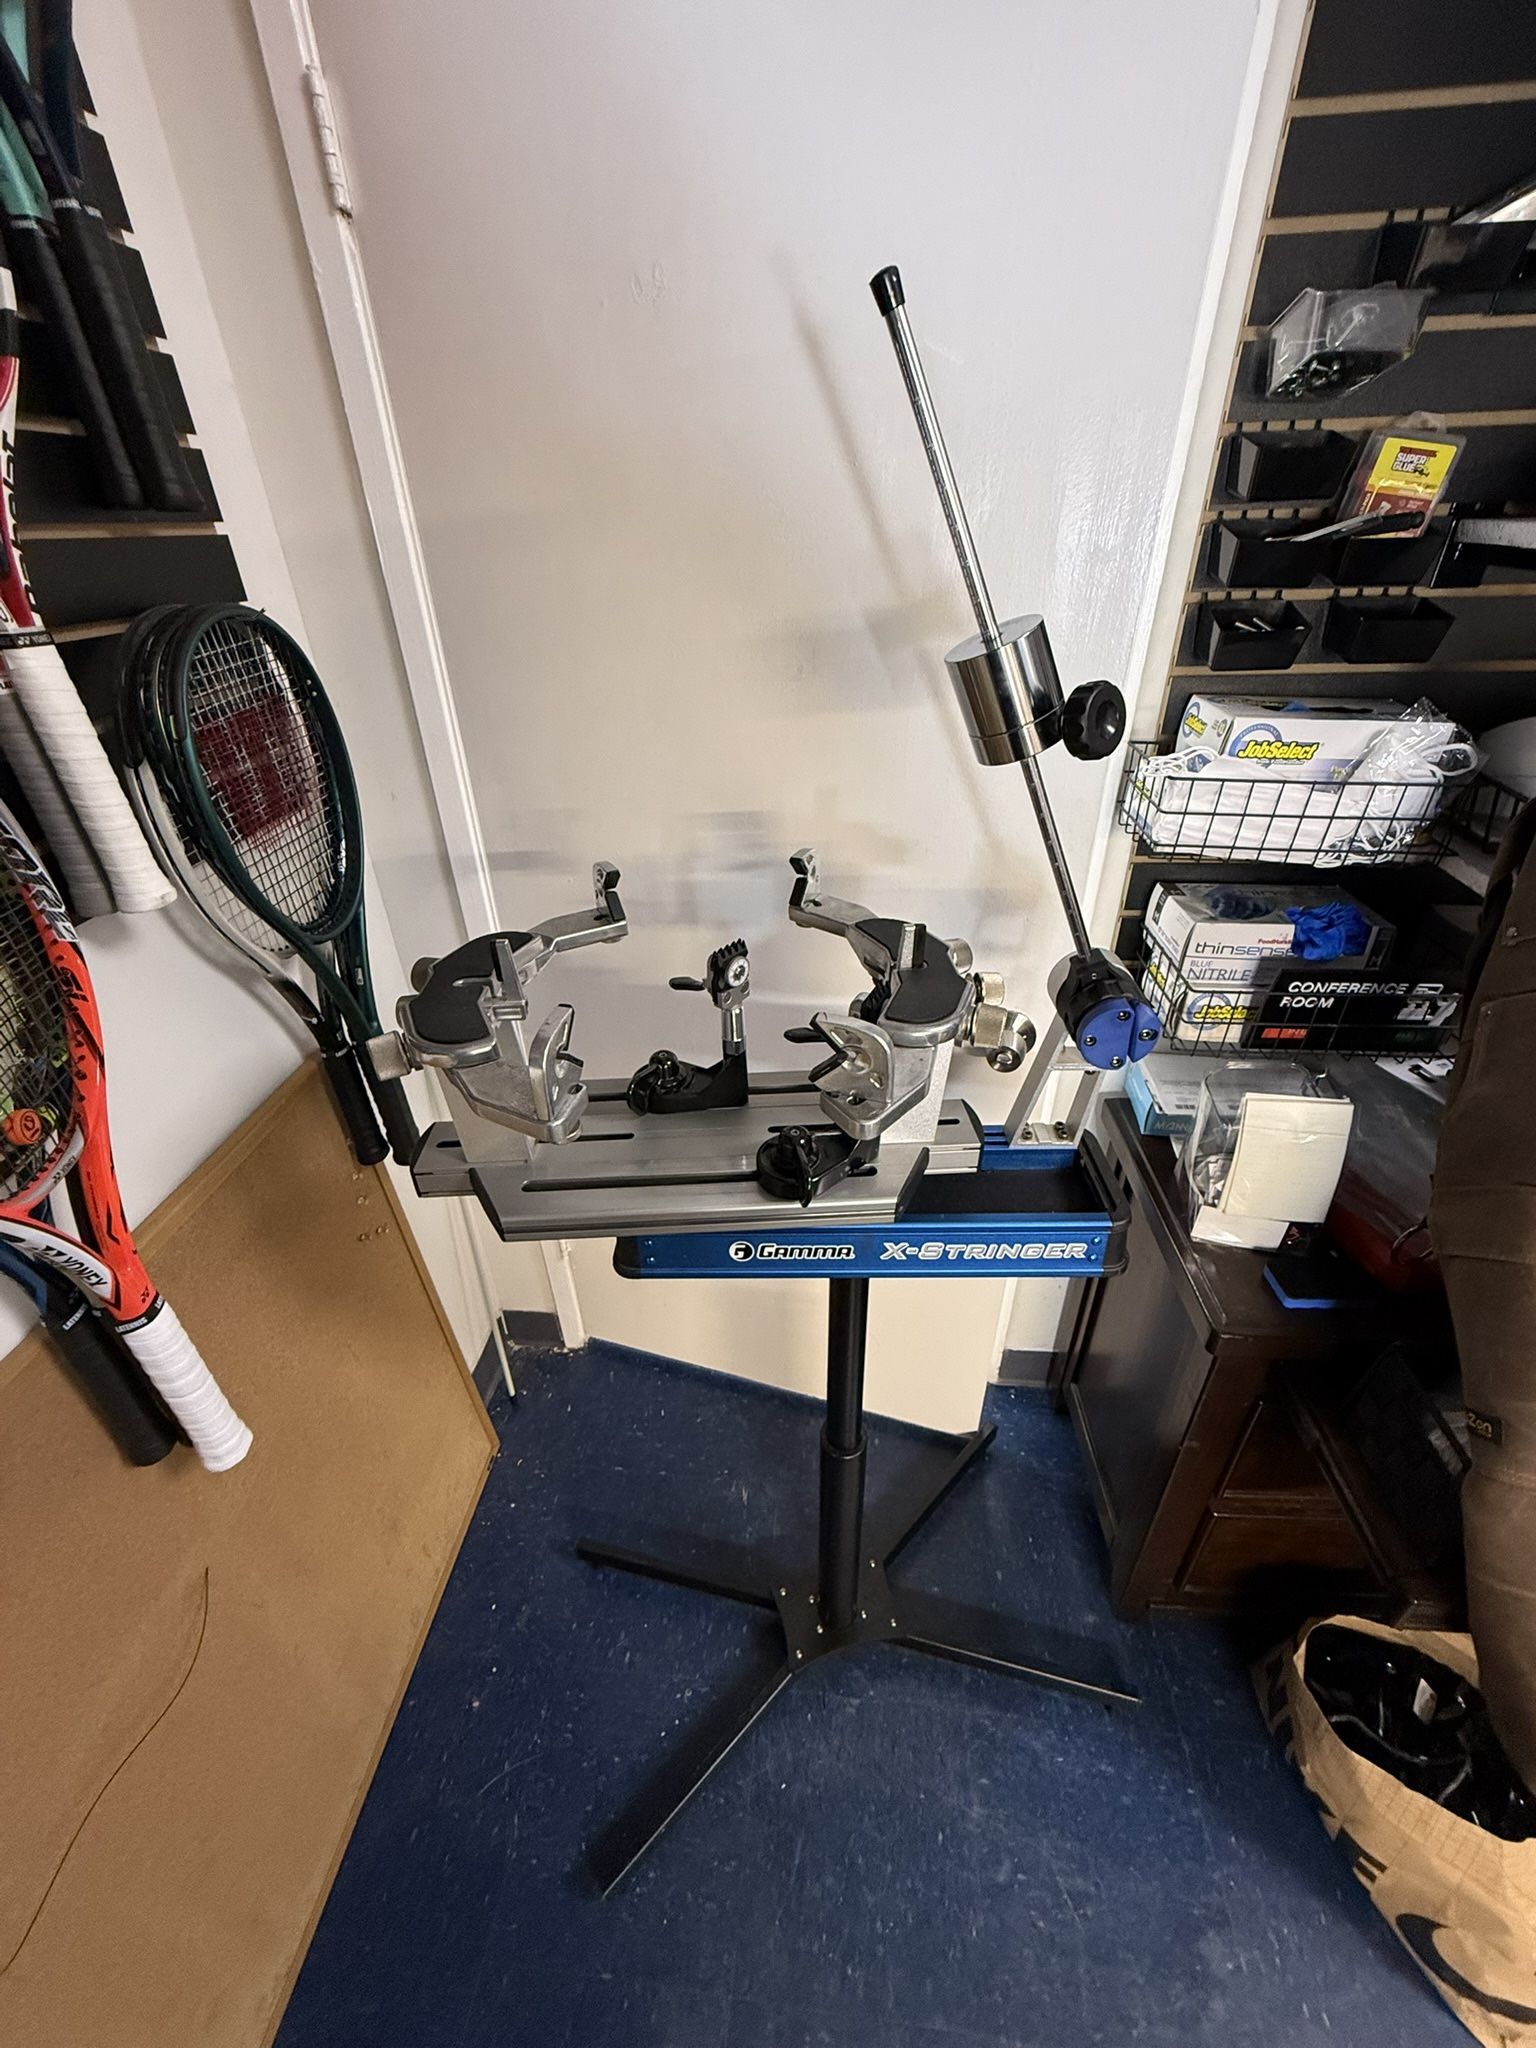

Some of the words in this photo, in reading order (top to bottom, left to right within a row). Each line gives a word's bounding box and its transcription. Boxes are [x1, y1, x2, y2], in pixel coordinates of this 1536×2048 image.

[1396, 452, 1427, 465] SUPER
[1392, 461, 1416, 473] GLUE
[1238, 740, 1319, 760] JobSelect
[1187, 968, 1253, 981] NITRILE
[1288, 981, 1409, 995] CONFERENCE
[1280, 996, 1335, 1008] ROOM
[880, 1242, 1088, 1260] X-STRINGER
